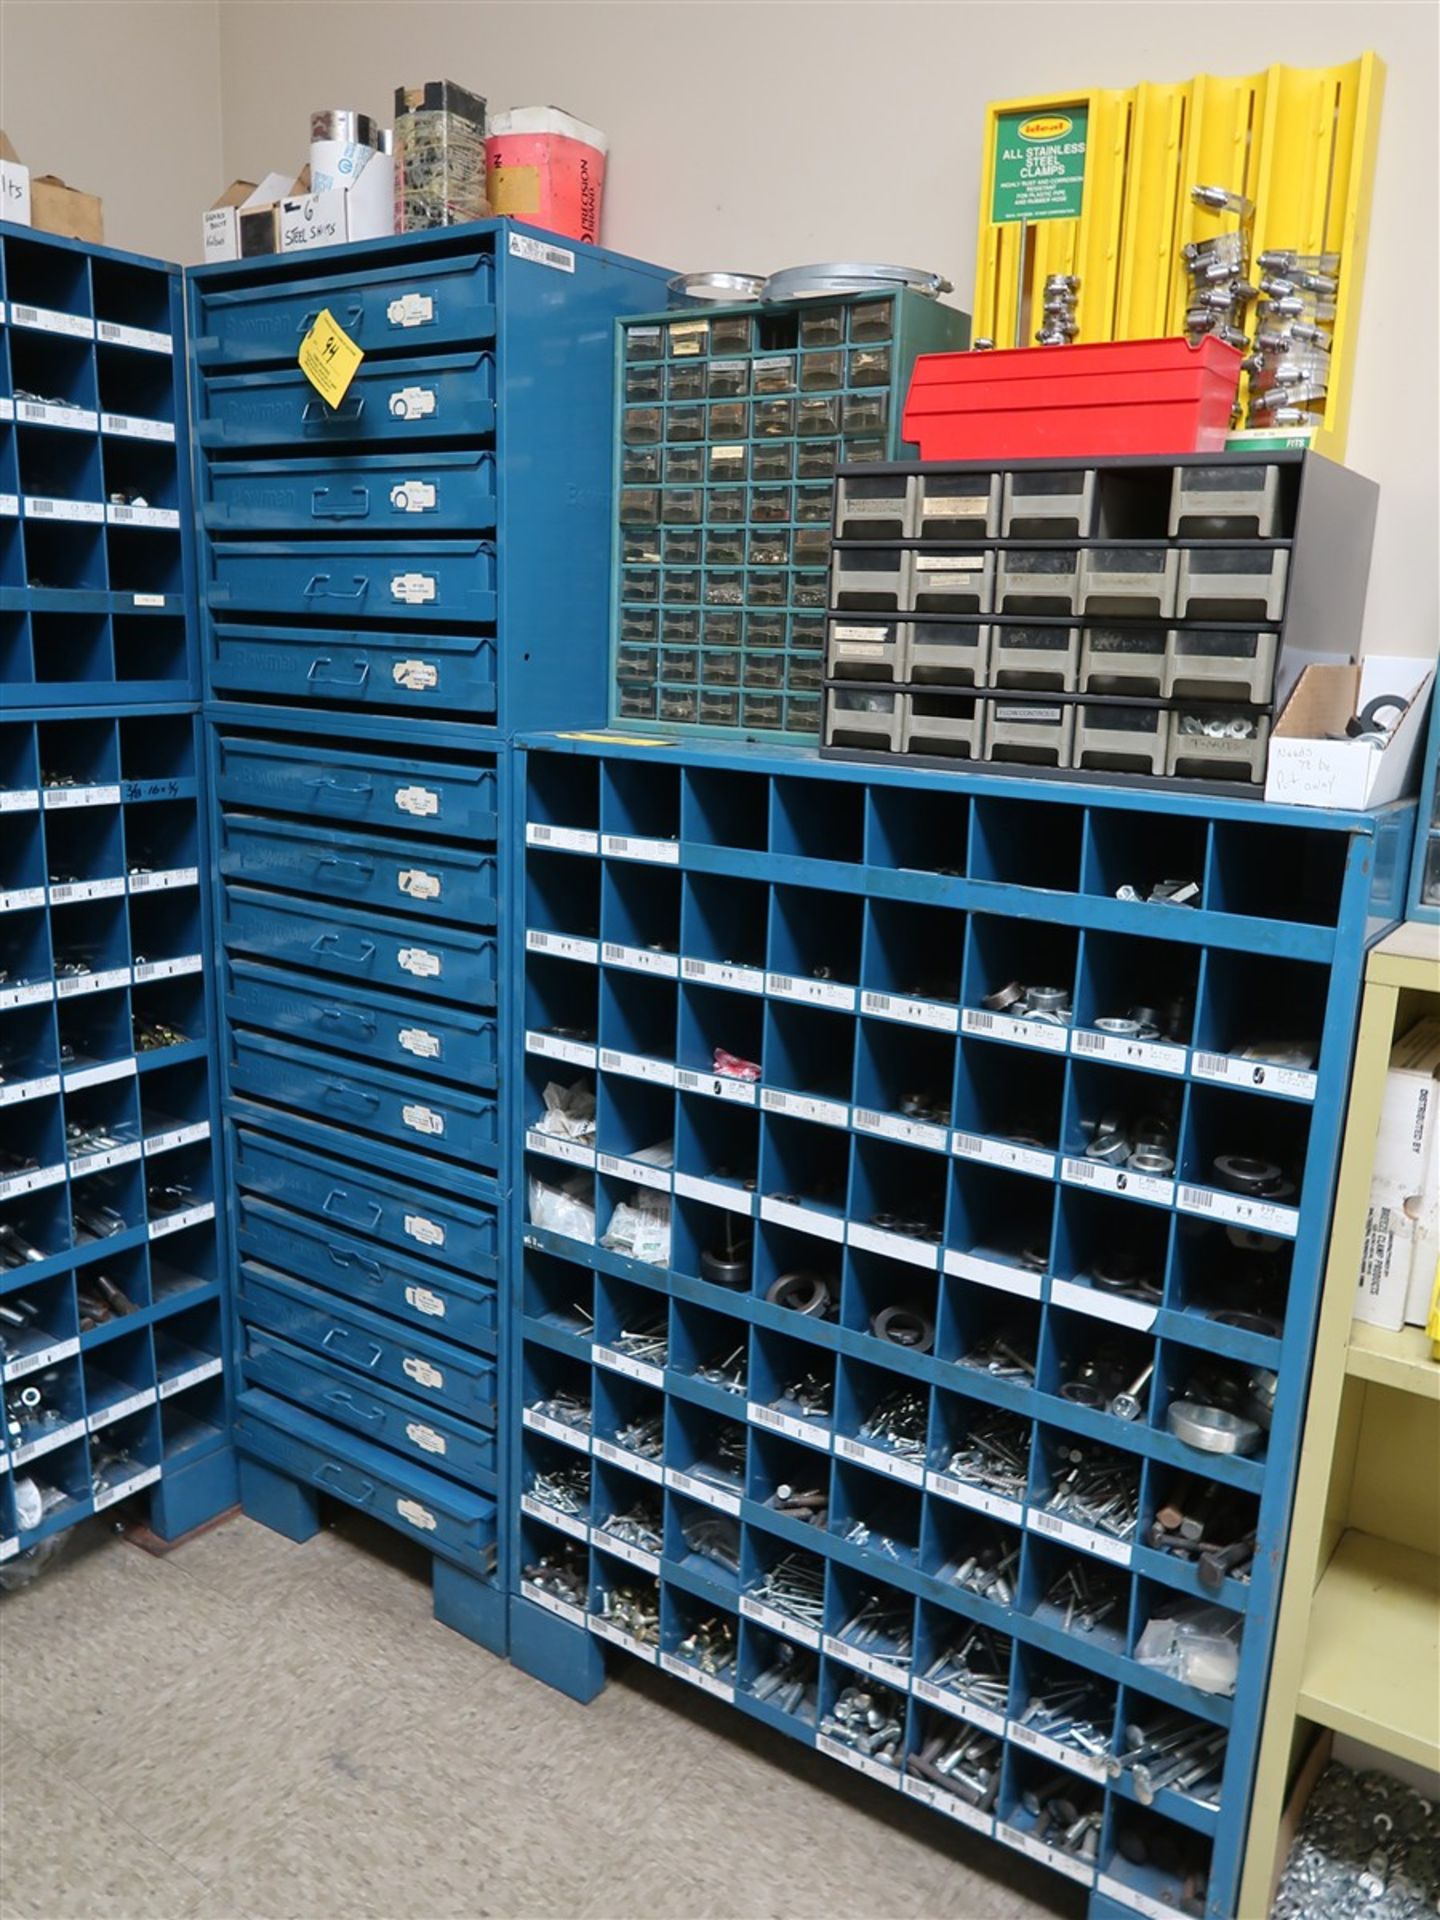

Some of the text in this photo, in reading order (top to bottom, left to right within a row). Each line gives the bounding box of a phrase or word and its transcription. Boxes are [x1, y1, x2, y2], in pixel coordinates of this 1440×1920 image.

[1025, 122, 1064, 133] ideal
[1002, 142, 1086, 160] ALL STAINLESS
[1026, 156, 1061, 167] STEEL
[1020, 165, 1066, 178] CLAMPS
[2, 174, 23, 199] lts
[579, 159, 590, 231] PRECISION
[1412, 1088, 1429, 1154] DISTRIBUTED BY
[1376, 1234, 1387, 1258] CLAMP
[1370, 1260, 1383, 1295] PRODUCTS
